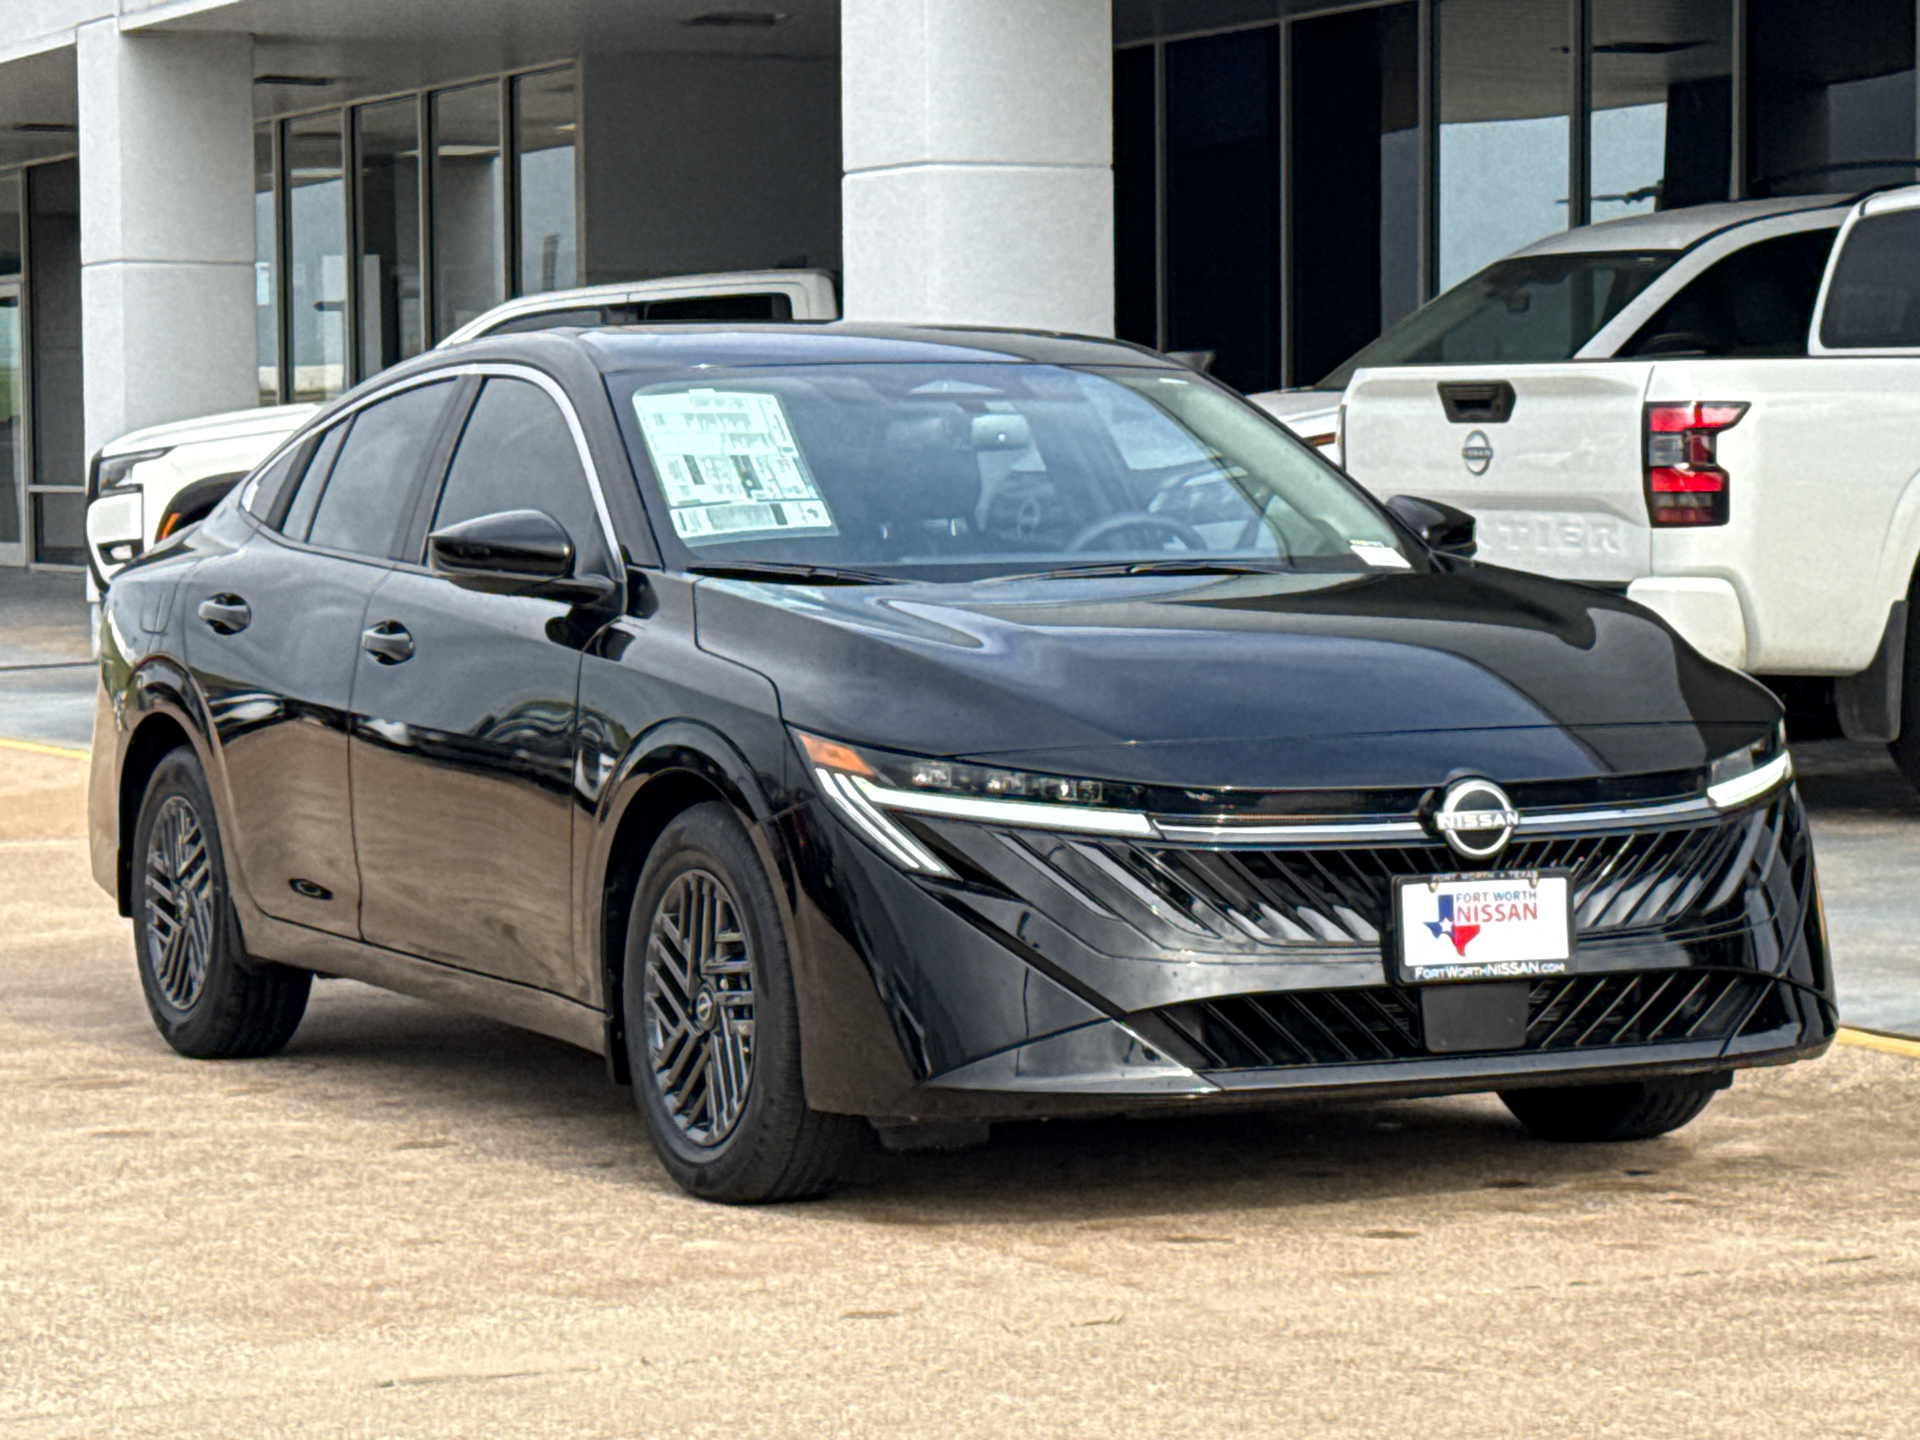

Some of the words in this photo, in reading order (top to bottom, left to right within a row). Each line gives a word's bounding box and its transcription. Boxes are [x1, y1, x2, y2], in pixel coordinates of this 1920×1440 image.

[1438, 812, 1519, 831] NISSAN
[1456, 892, 1489, 903] FORT
[1493, 891, 1537, 902] WORTH
[1457, 903, 1538, 924] NISSAN
